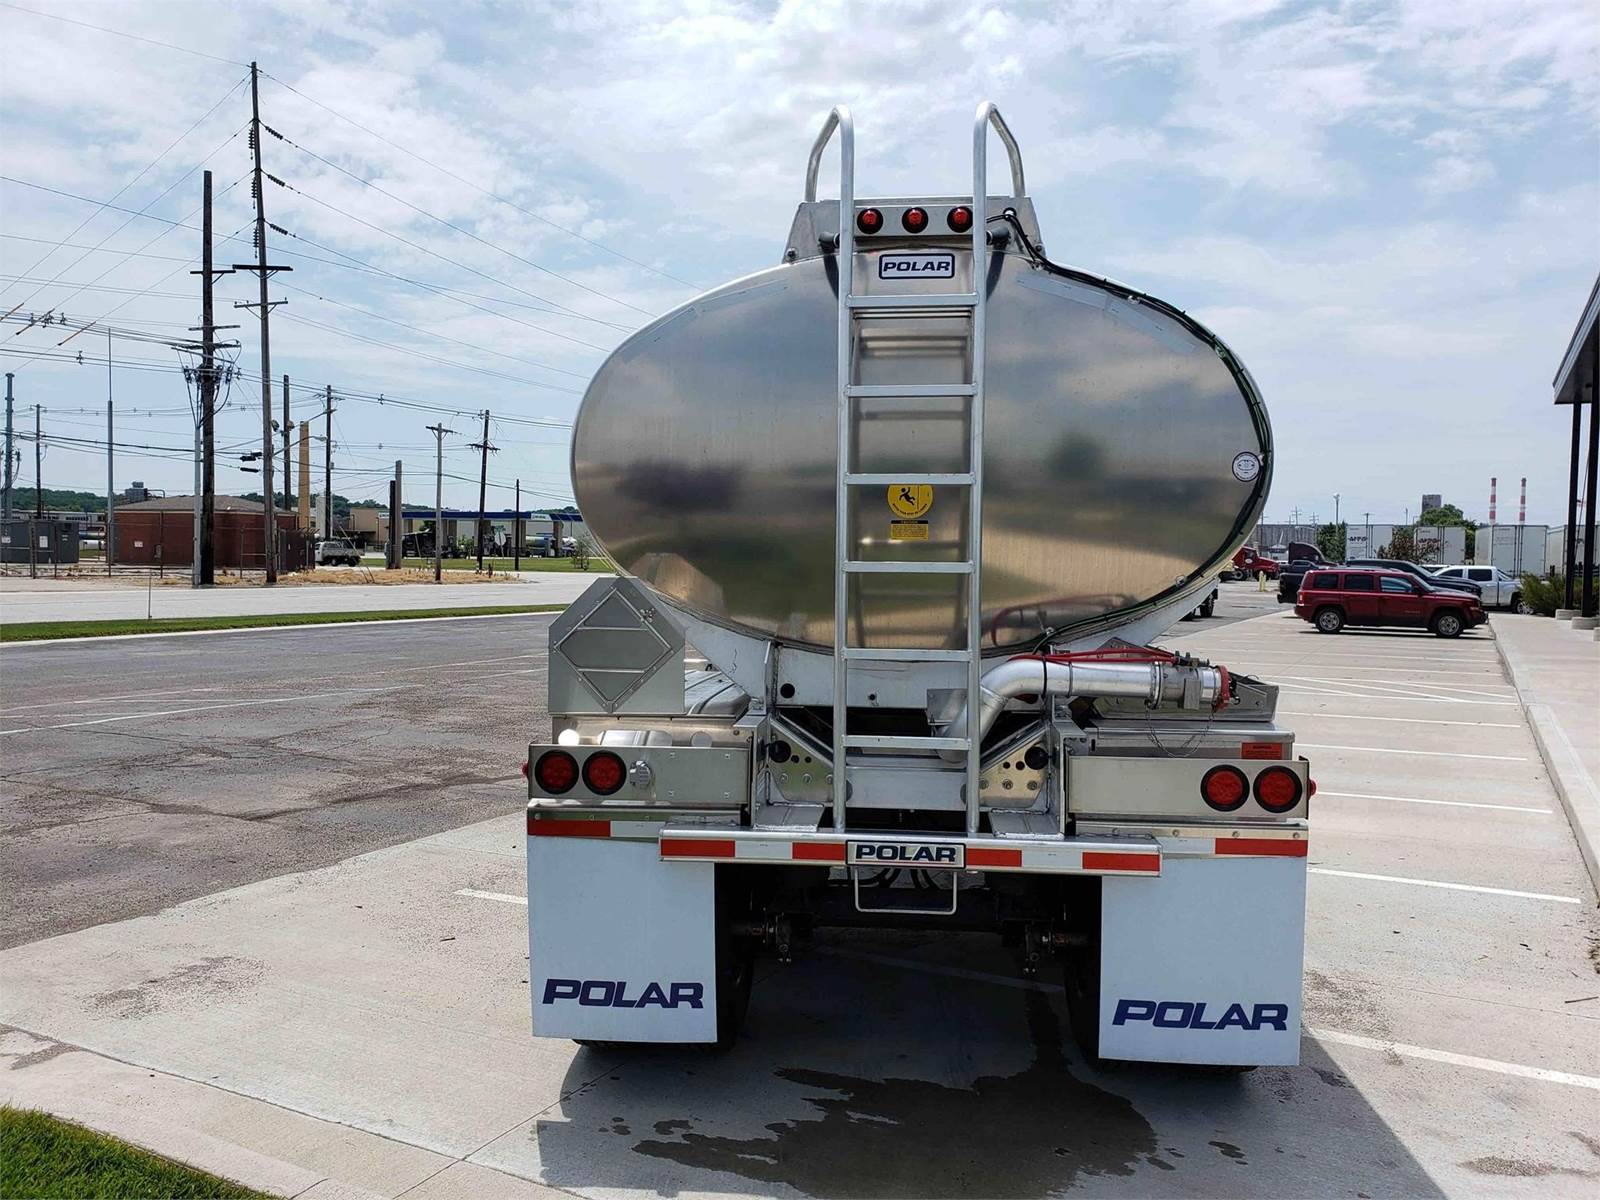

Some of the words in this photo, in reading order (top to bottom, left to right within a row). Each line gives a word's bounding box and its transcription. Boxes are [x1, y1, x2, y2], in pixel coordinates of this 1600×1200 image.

[883, 261, 951, 272] POLAR
[855, 844, 957, 862] POLAR
[542, 978, 704, 1009] POLAR
[1112, 999, 1288, 1031] POLAR
